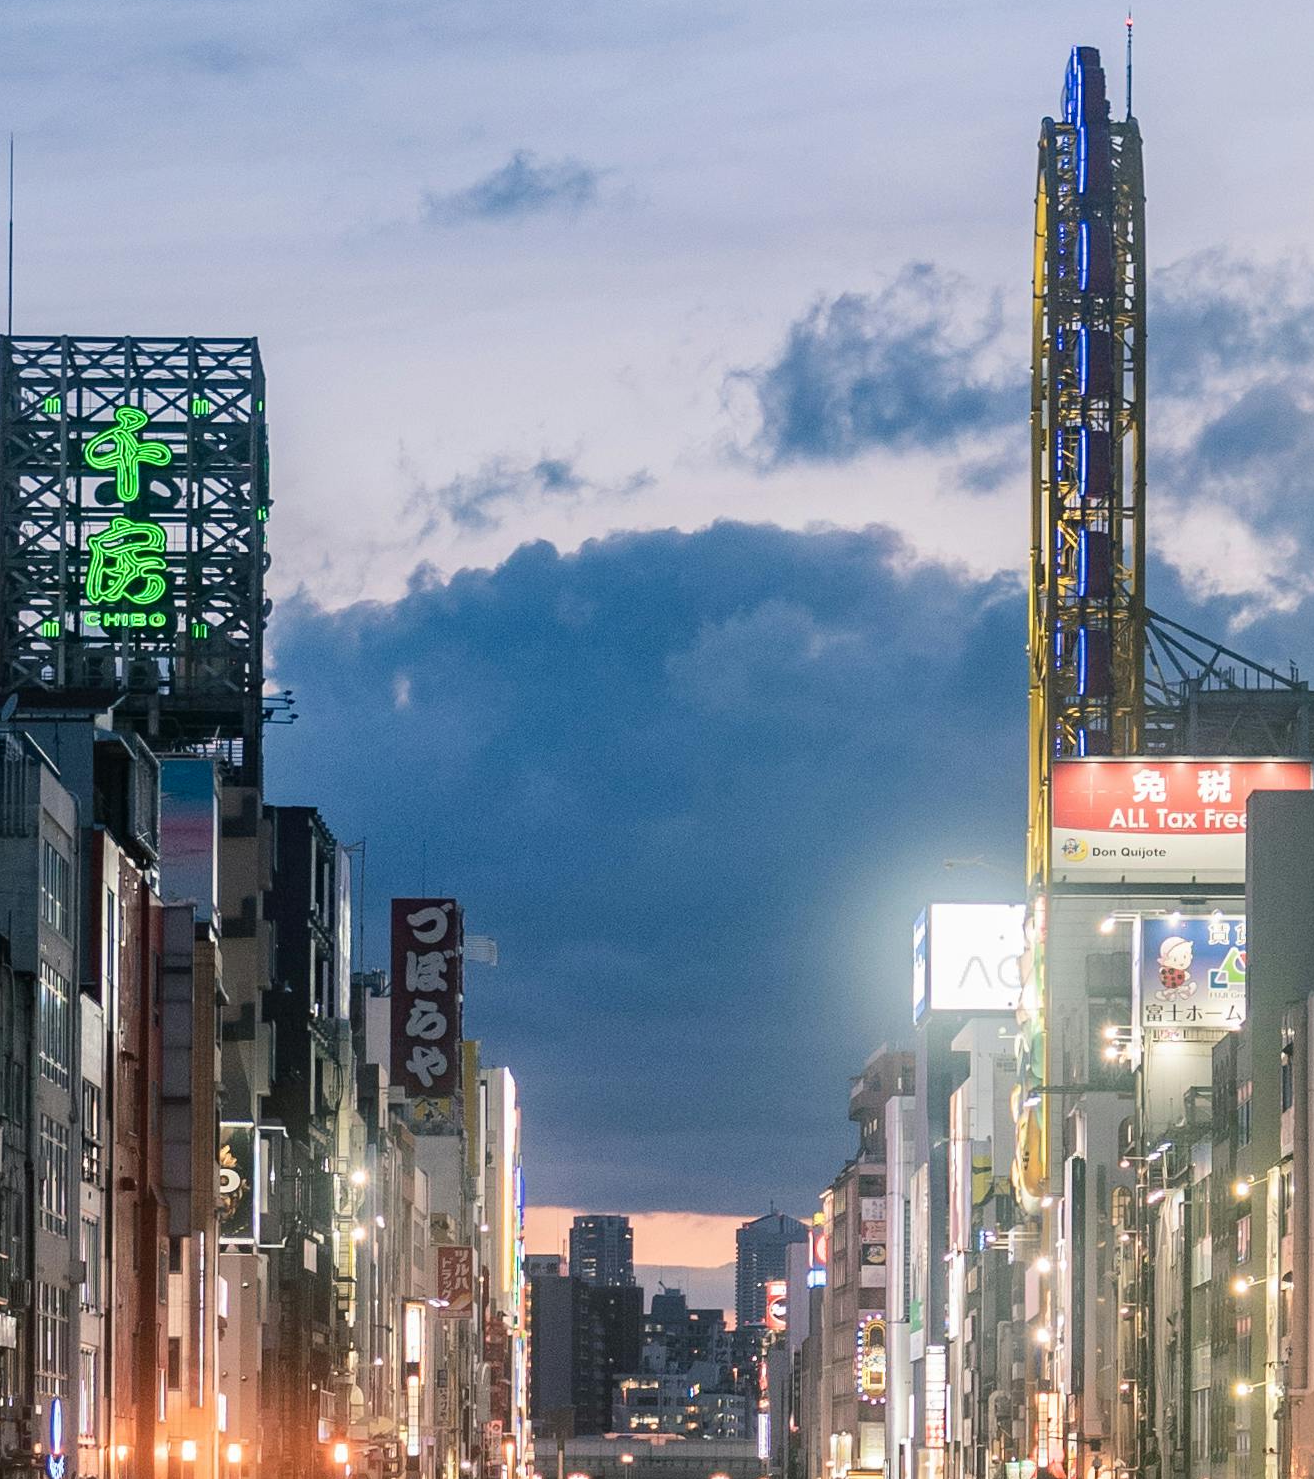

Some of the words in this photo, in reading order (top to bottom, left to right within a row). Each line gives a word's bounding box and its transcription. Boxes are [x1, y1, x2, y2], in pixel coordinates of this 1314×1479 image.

[84, 407, 173, 605] 千房
[85, 612, 166, 628] CHIBO
[1132, 768, 1233, 804] 免税
[1108, 808, 1149, 829] ALL
[1156, 809, 1198, 829] Tax
[1092, 847, 1117, 858] Don
[1120, 846, 1167, 860] Quijote
[405, 902, 456, 1088] づぼらや
[1145, 1003, 1243, 1022] 富士ホーム
